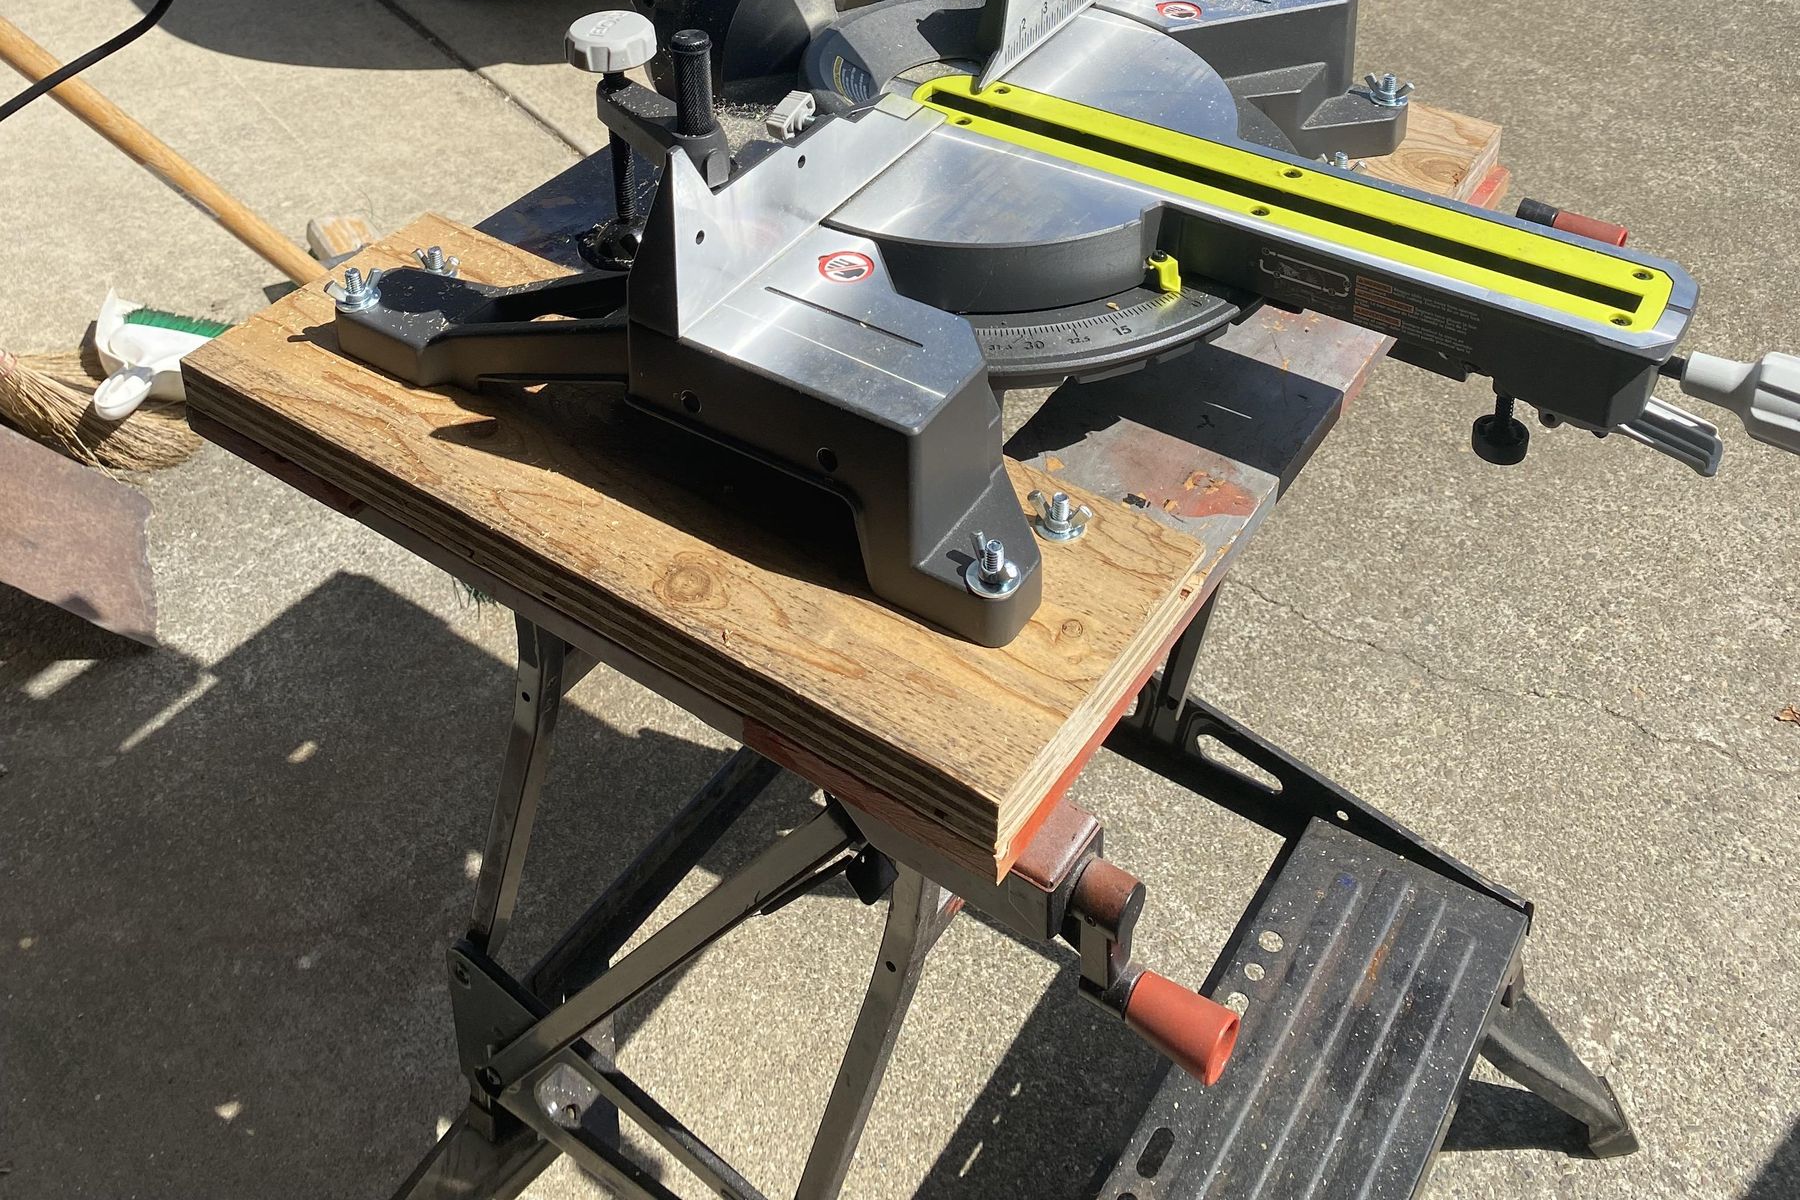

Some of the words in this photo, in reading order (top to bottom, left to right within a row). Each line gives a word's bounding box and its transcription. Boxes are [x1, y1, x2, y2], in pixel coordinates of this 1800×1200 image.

[1021, 17, 1026, 30] 2
[1042, 1, 1048, 14] 3
[1023, 340, 1045, 350] 30
[1112, 324, 1132, 336] 15
